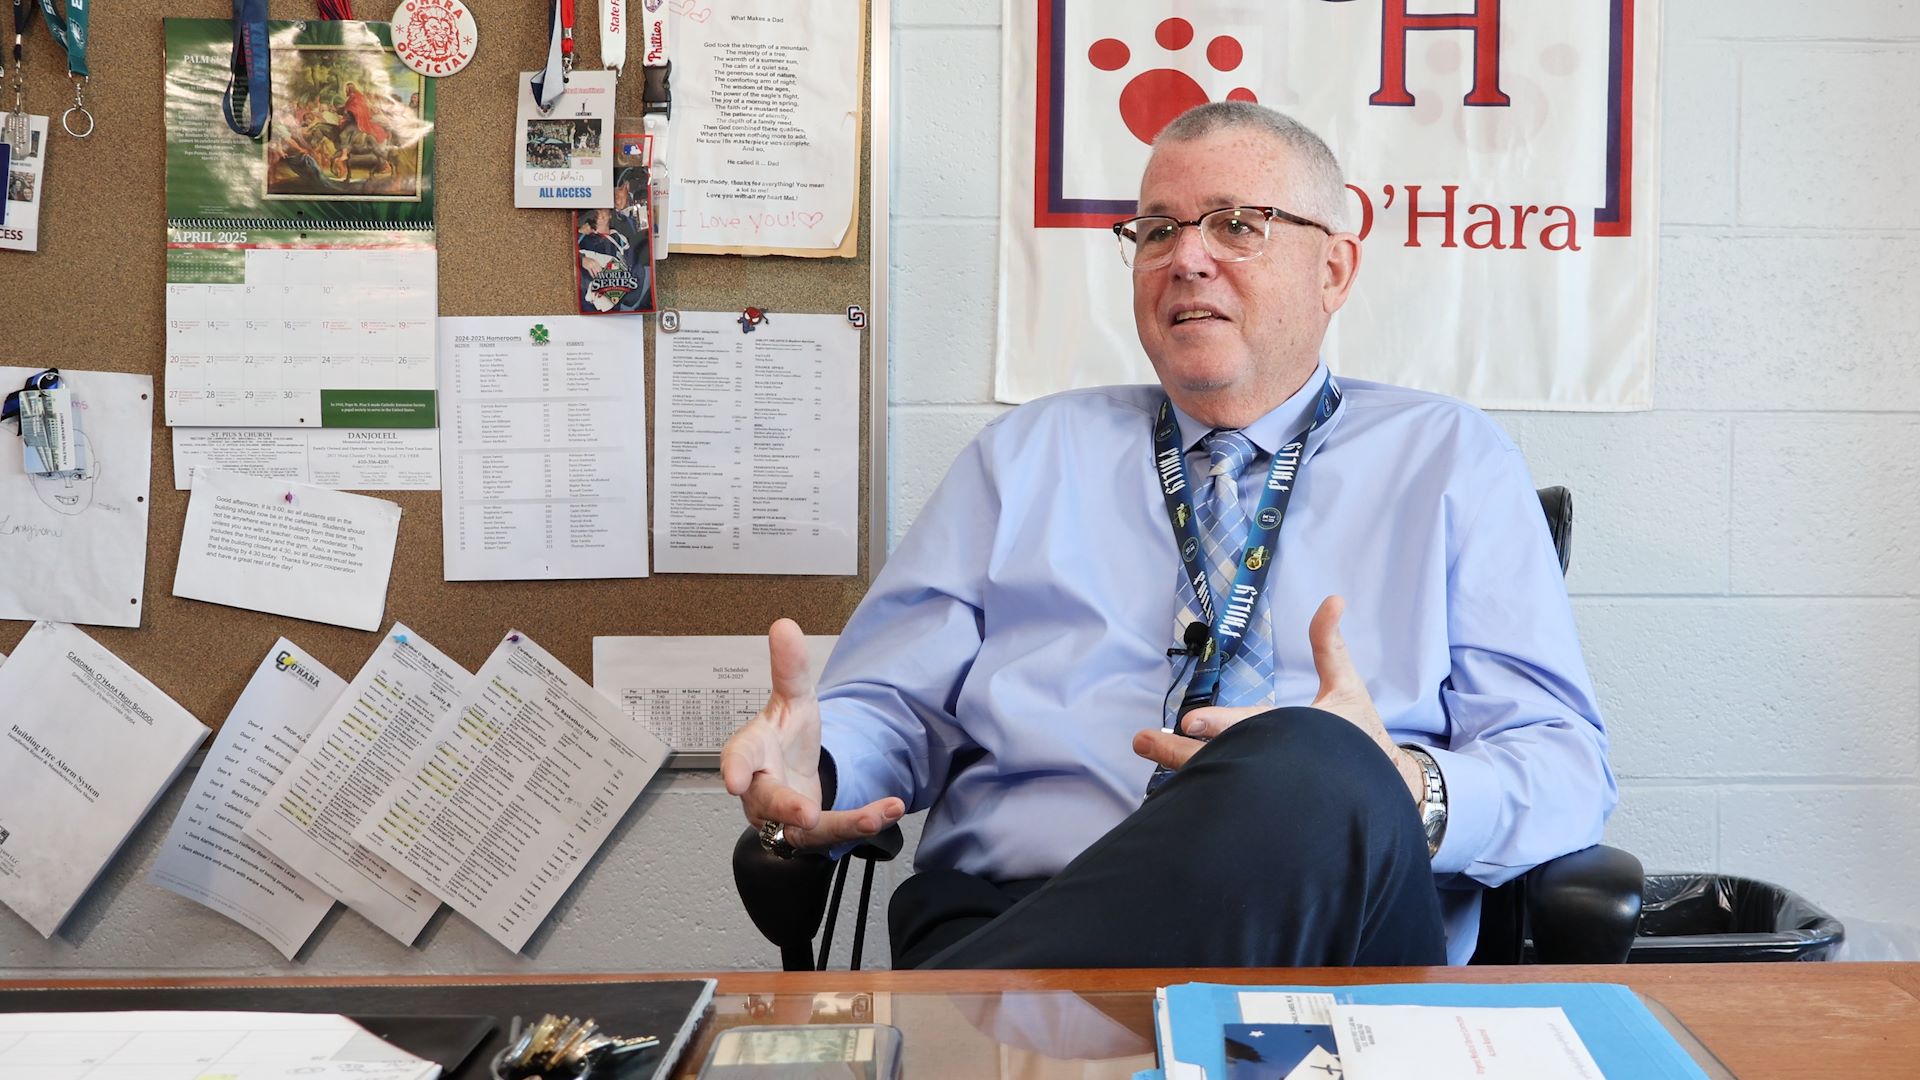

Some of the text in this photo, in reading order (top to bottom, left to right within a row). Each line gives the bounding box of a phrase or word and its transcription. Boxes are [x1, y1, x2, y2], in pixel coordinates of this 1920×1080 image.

[648, 20, 662, 62] Phillies
[184, 55, 209, 64] PALM
[397, 42, 467, 73] OFFICIAL
[539, 187, 592, 198] ALL ACCESS
[672, 210, 687, 227] I
[173, 231, 247, 243] APRIL 2025
[592, 278, 638, 291] SERIES
[598, 271, 631, 280] WORLD
[171, 320, 178, 328] 13
[245, 391, 253, 399] 29
[284, 391, 293, 399] 30
[1158, 447, 1186, 495] PHILLY
[1268, 442, 1303, 492] PHILLY
[214, 503, 237, 513] building
[237, 508, 256, 516] should
[322, 522, 346, 532] Students
[216, 495, 232, 503] Good
[303, 512, 326, 520] students
[212, 520, 230, 528] unless
[352, 543, 363, 551] This
[1193, 571, 1215, 627] PHILLY
[1218, 583, 1258, 638] PHILLY
[68, 651, 154, 724] CARDINAL O'HARA HIGH SCHOOL
[544, 696, 599, 742] Varsity Basketball (Boys)
[11, 724, 100, 798] Building Fire Alarm System
[256, 755, 284, 776] CCC Hallway
[247, 766, 276, 786] CCC Hallway
[207, 825, 239, 843] Administration
[238, 840, 257, 853] Hallway
[256, 851, 267, 859] Rear
[270, 860, 285, 871] Lower
[284, 868, 297, 879] Level
